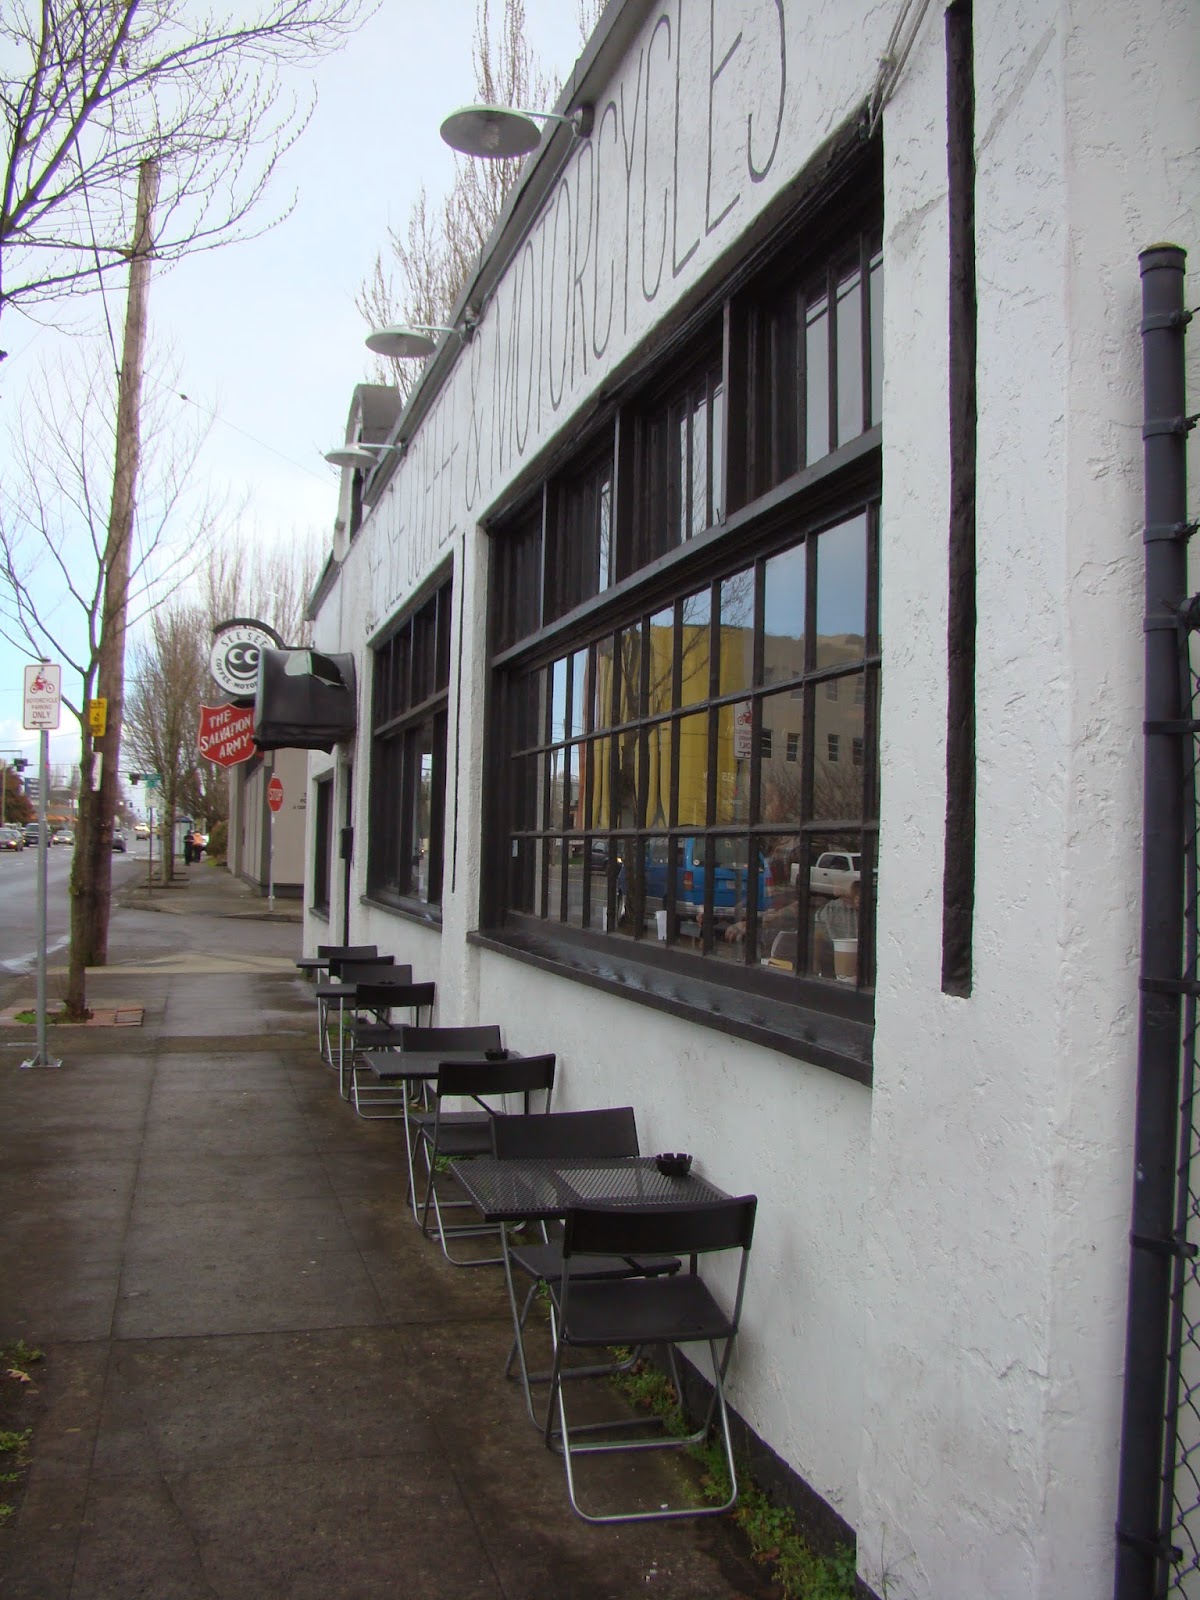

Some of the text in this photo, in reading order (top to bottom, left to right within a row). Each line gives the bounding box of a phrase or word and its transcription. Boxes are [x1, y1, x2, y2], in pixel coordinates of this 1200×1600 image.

[407, 368, 460, 587] COFFEE
[221, 631, 269, 648] SEE SEE
[215, 658, 232, 684] COFFEE
[32, 711, 51, 719] ONLY
[209, 709, 231, 728] THE
[201, 714, 251, 752] SALVATION
[218, 733, 250, 758] ARMY
[269, 788, 283, 801] STOP
